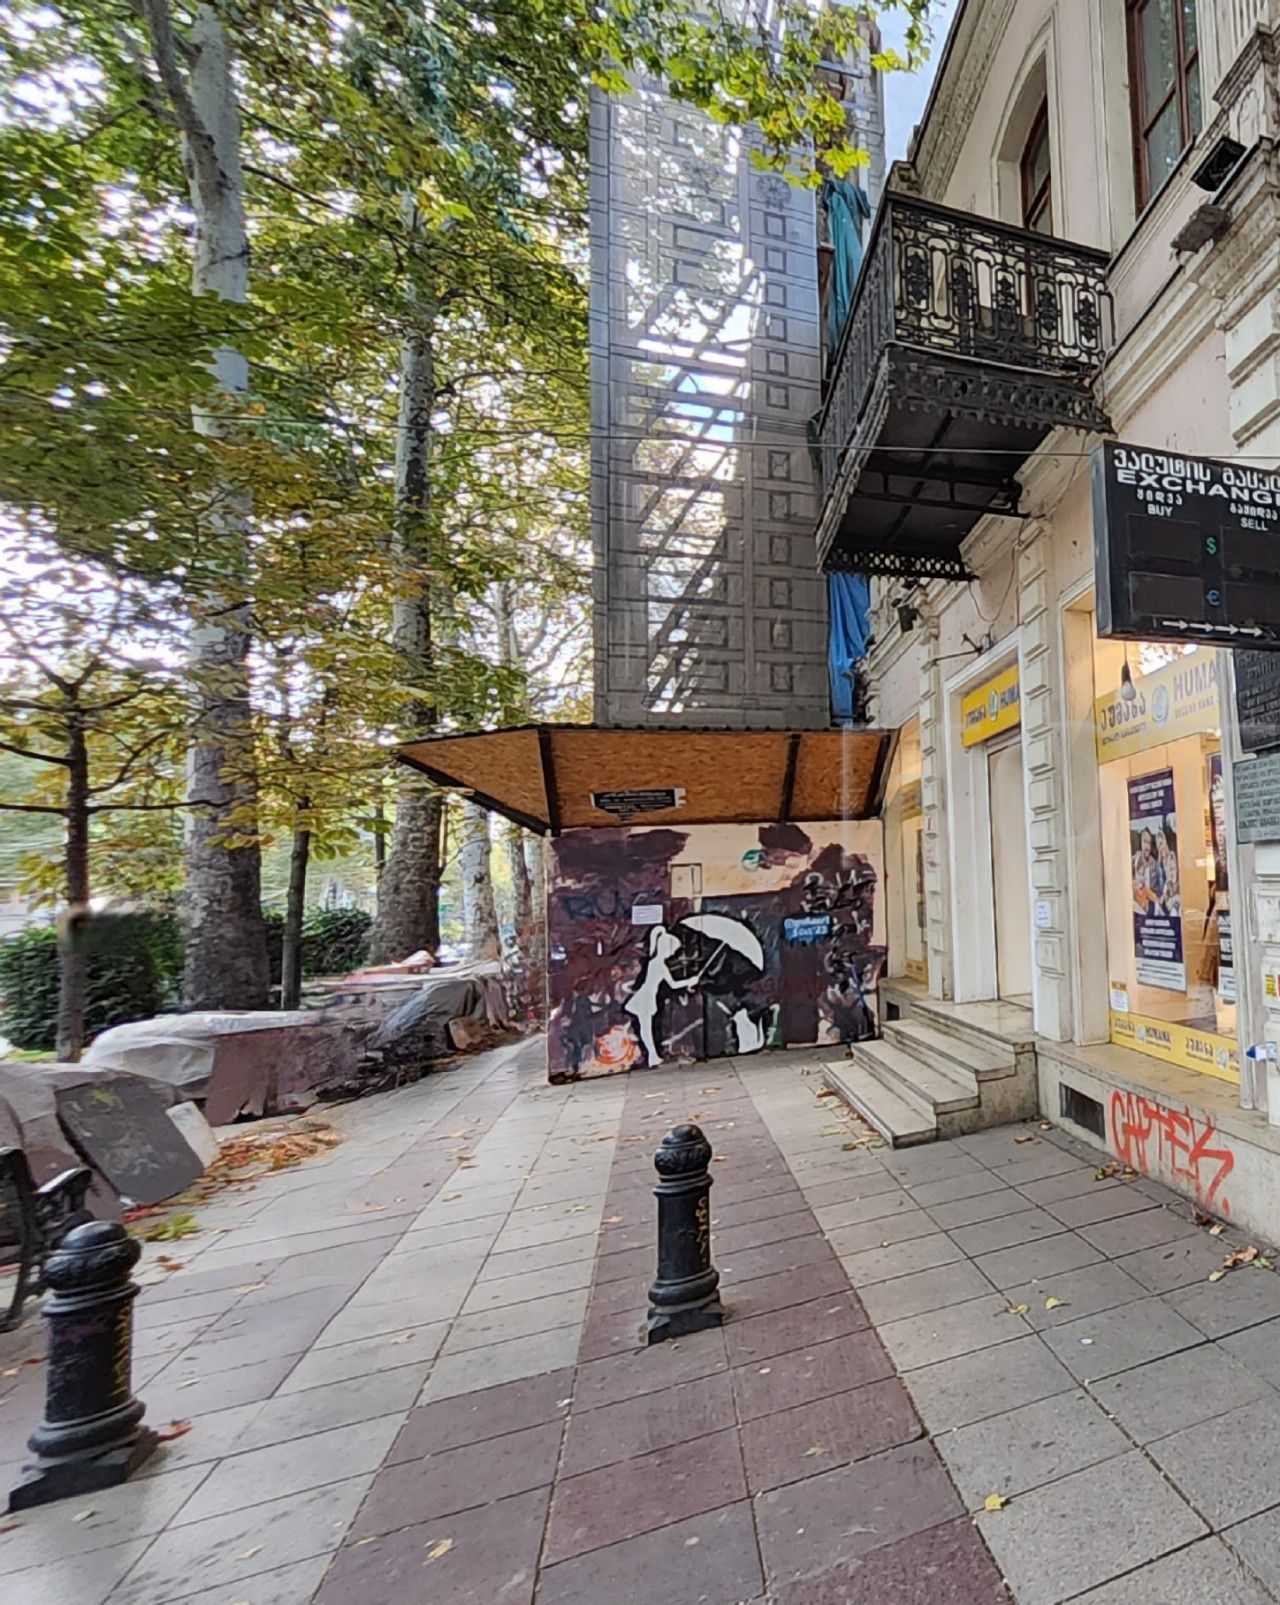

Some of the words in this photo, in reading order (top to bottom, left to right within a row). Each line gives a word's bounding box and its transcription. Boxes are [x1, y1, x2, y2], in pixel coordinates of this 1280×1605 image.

[1113, 448, 1211, 482] ვალუტის
[1147, 503, 1173, 517] BUY
[1240, 517, 1268, 531] SELL
